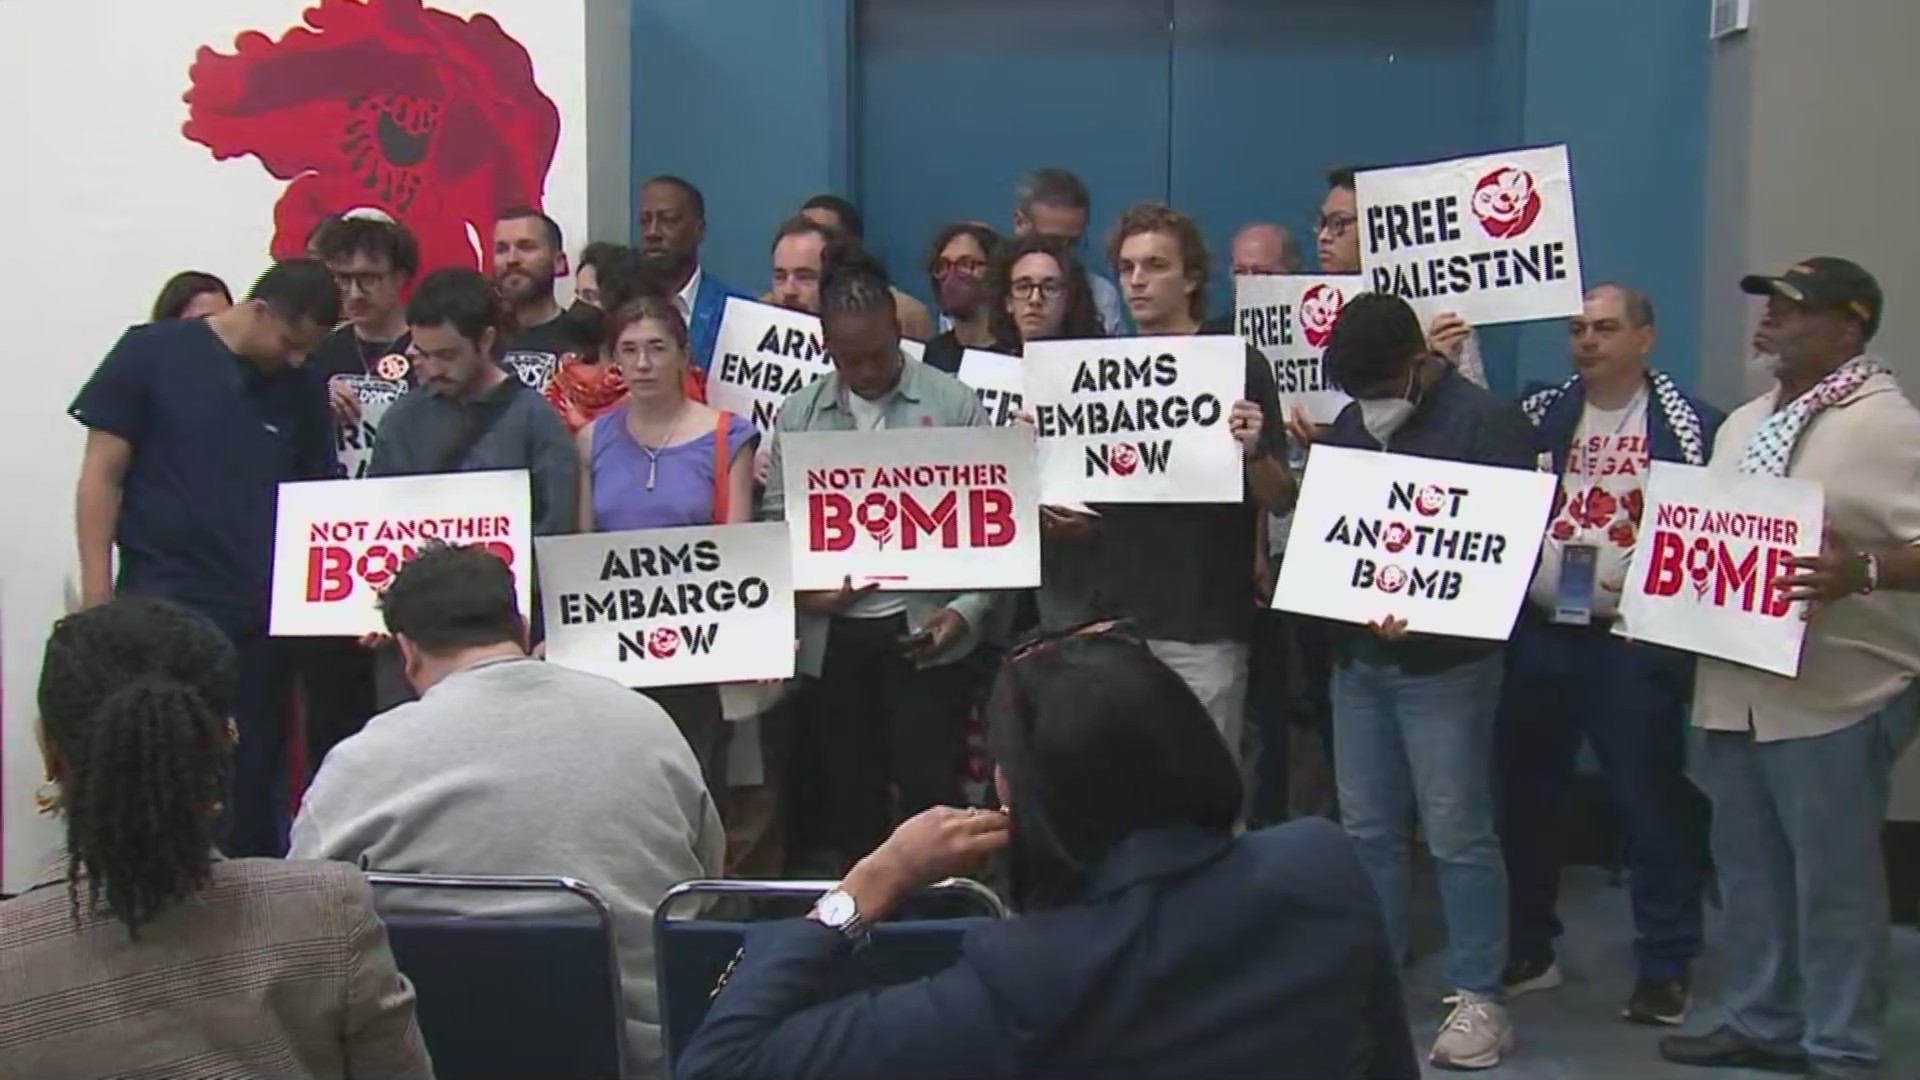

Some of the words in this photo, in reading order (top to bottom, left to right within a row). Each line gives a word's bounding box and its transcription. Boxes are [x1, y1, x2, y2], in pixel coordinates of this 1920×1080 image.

[1367, 195, 1460, 254] FREE
[1372, 242, 1566, 300] PALESTINE
[757, 325, 831, 366] ARM
[1240, 304, 1293, 348] FREE
[720, 353, 818, 395] EMBA
[1071, 353, 1178, 394] ARMS
[1036, 392, 1221, 438] EMBARGO
[807, 467, 865, 490] NOT
[871, 464, 1007, 488] ANOTHER
[1085, 439, 1172, 478] NOW
[1388, 480, 1468, 518] NOT
[310, 521, 369, 542] NOT
[375, 516, 510, 541] ANOTHER
[808, 489, 1017, 552] BOMB
[1325, 515, 1507, 564] ANOTHER
[1656, 504, 1699, 530] NOT
[1700, 509, 1798, 545] ANOTHER
[600, 540, 721, 581] ARMS
[1351, 558, 1463, 601] BOMB
[1644, 530, 1796, 617] BOMB
[559, 576, 769, 625] EMBARGO
[618, 623, 719, 662] NOW
